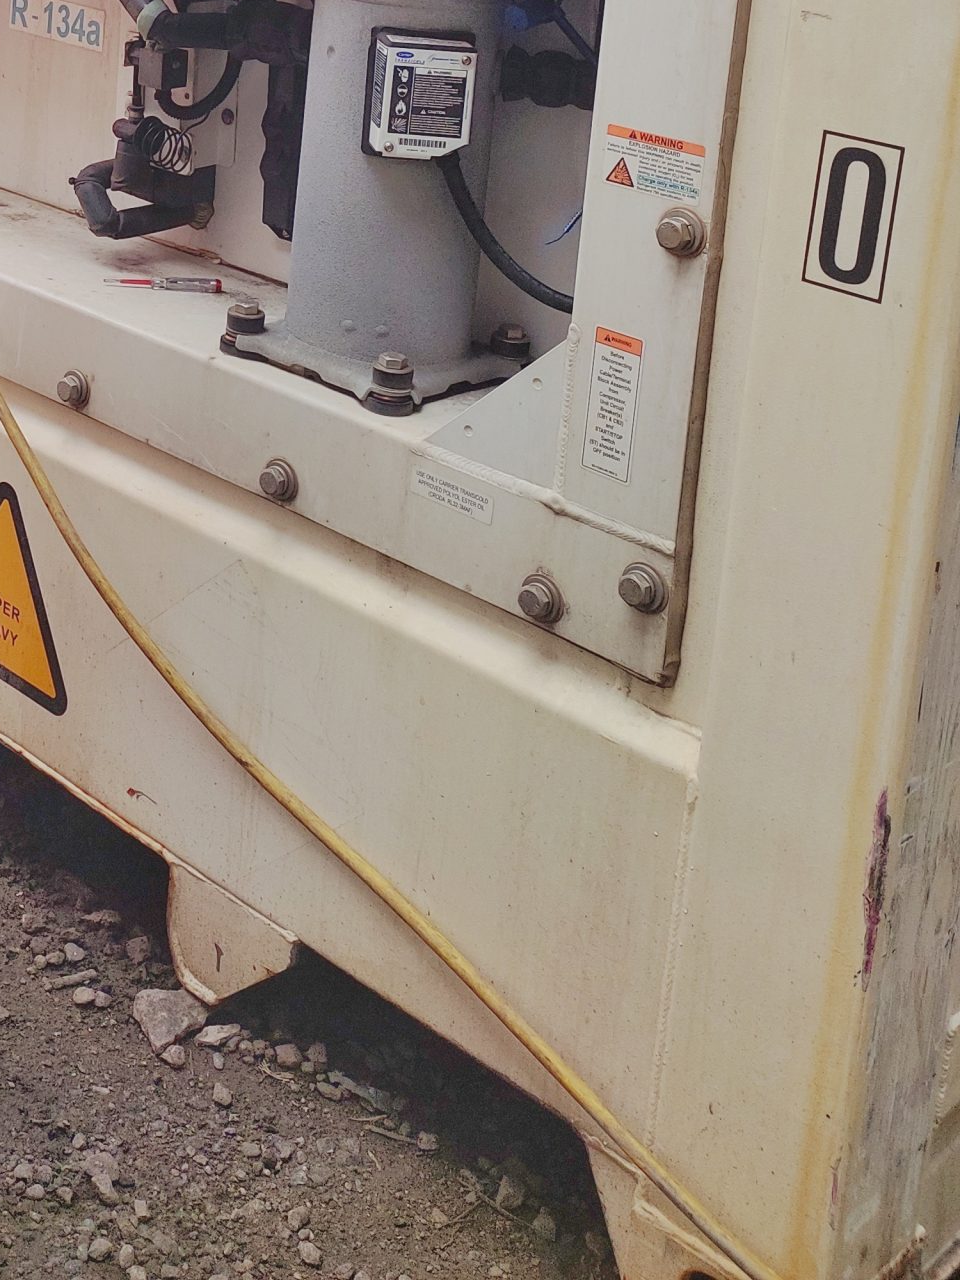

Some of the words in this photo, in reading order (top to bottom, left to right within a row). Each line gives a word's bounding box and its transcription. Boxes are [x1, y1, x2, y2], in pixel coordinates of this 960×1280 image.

[640, 131, 684, 150] WARNING
[628, 140, 658, 152] EXPLOSION
[658, 147, 681, 157] HAZARD
[638, 175, 656, 185] Charge
[610, 351, 625, 360] Before
[601, 355, 633, 371] Disconnecting
[600, 435, 616, 446] Switch
[599, 442, 614, 452] should
[461, 496, 477, 507] ESTER
